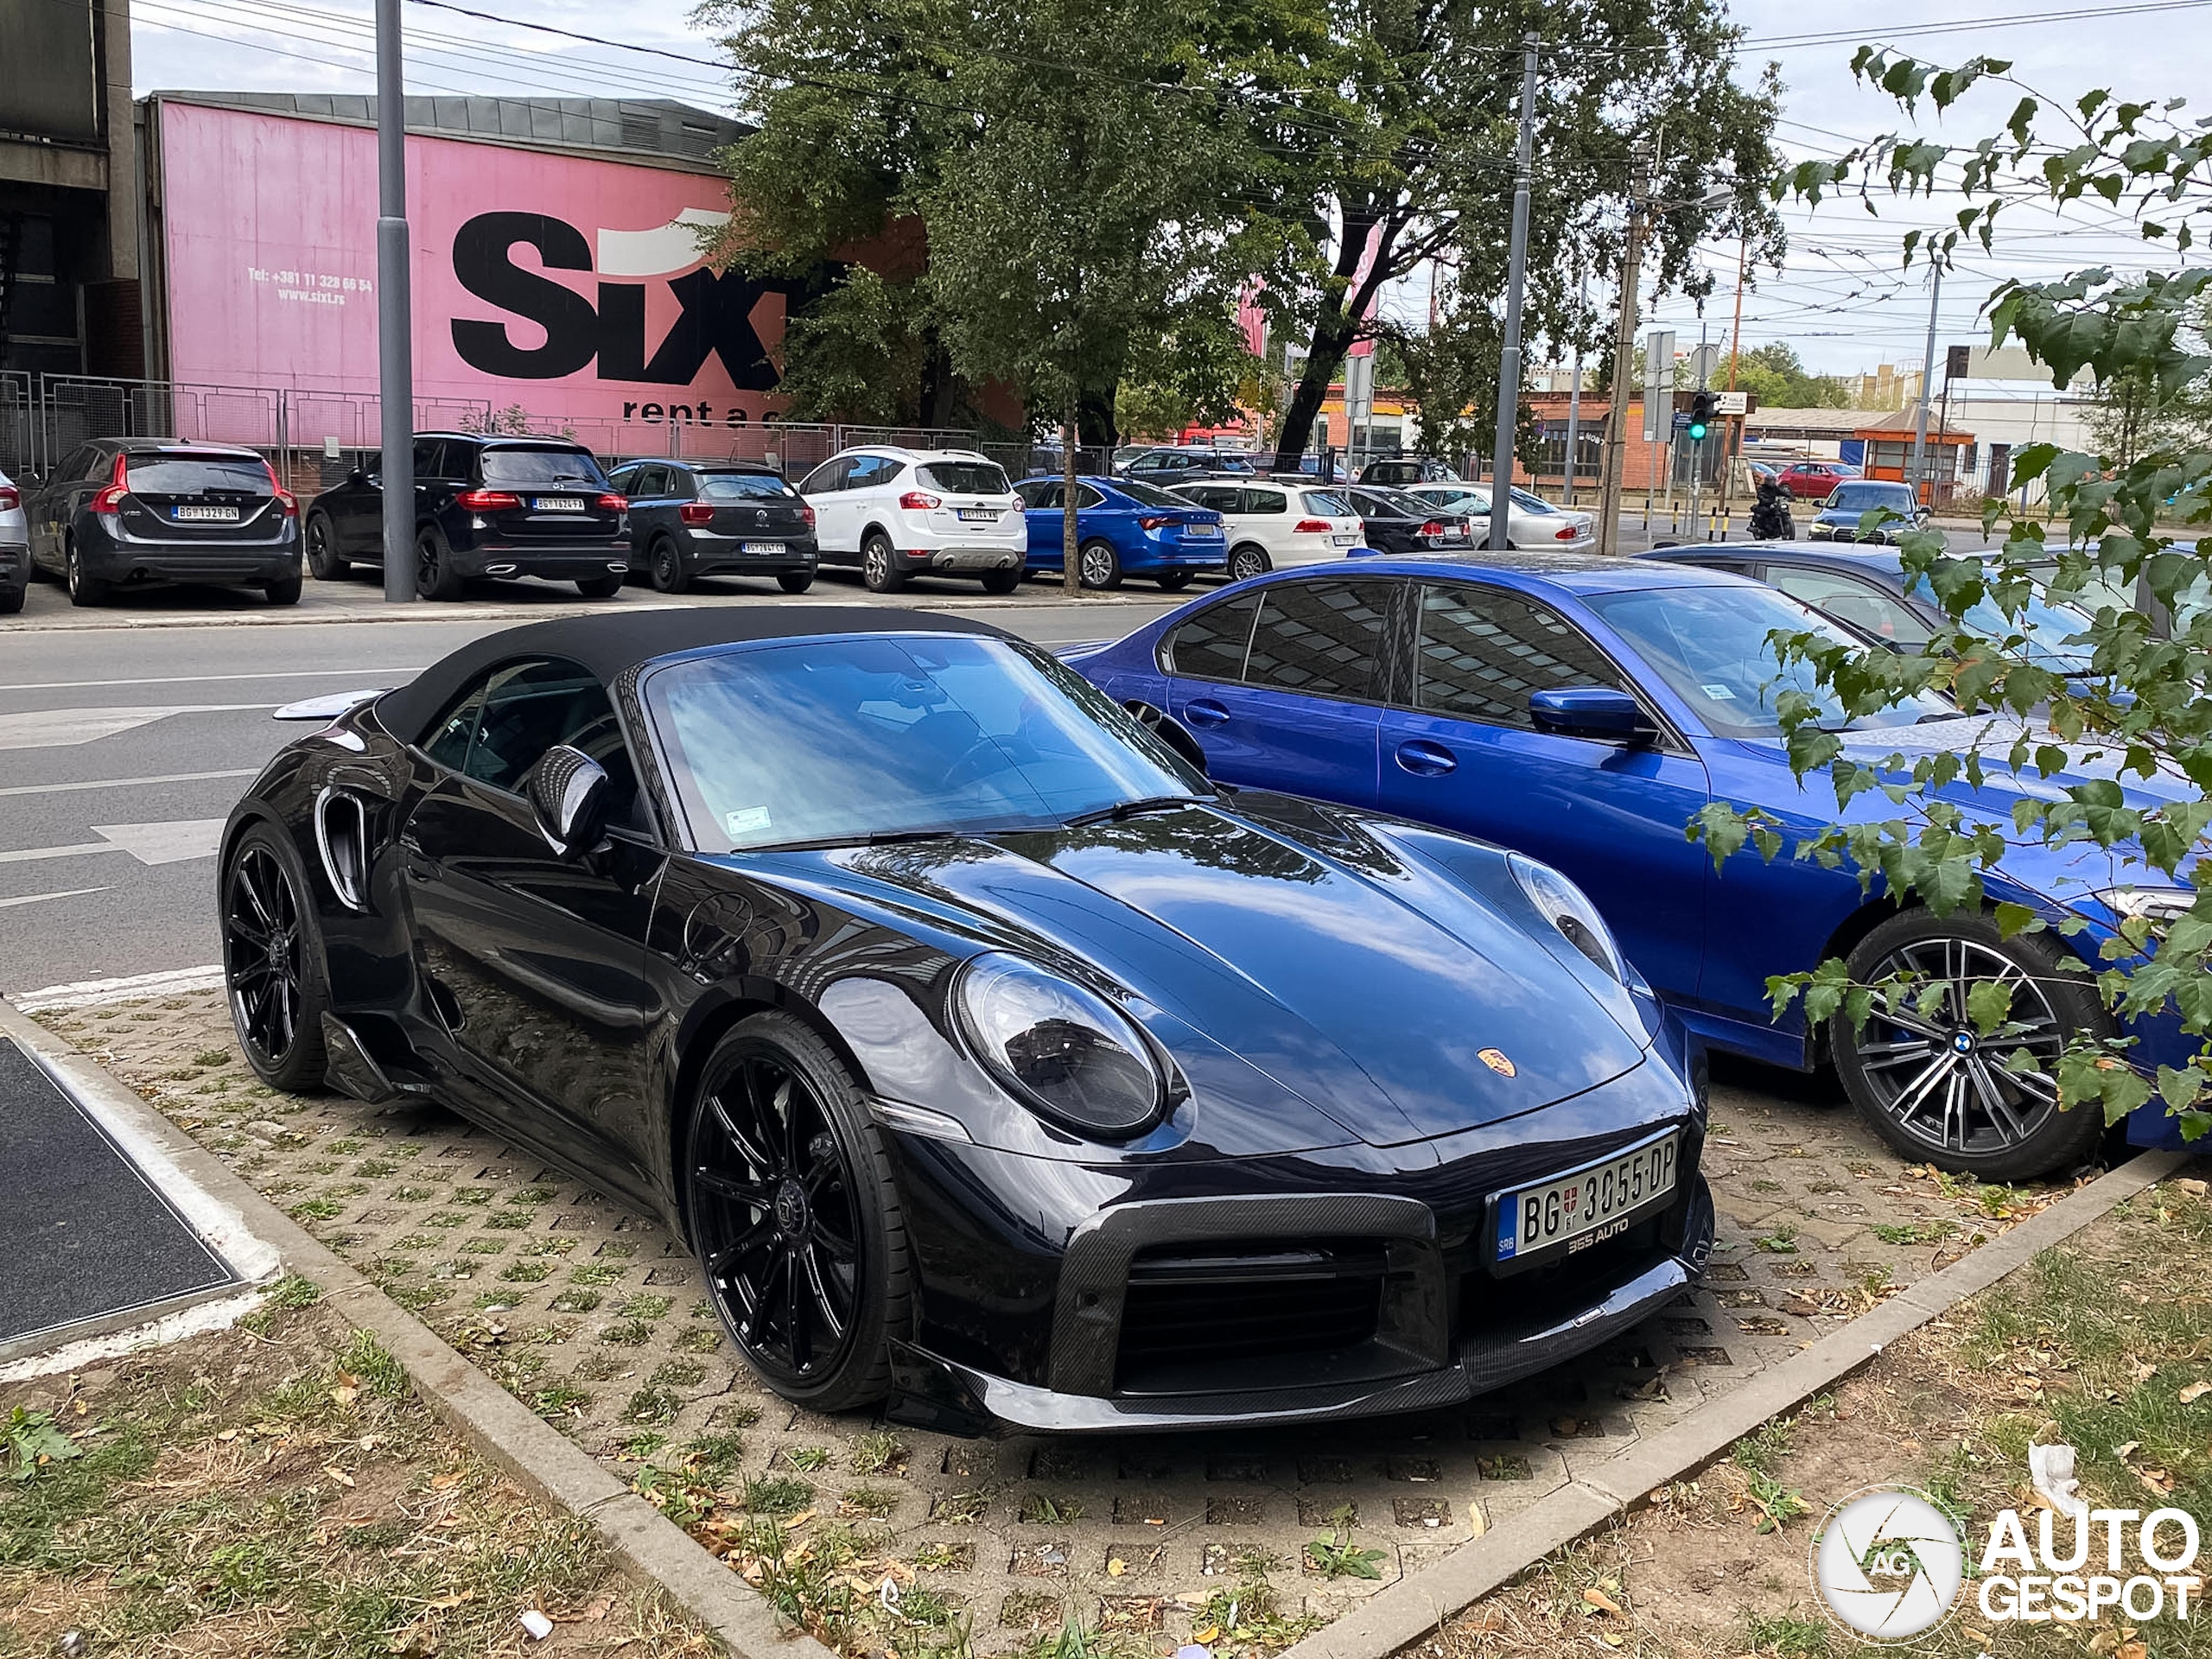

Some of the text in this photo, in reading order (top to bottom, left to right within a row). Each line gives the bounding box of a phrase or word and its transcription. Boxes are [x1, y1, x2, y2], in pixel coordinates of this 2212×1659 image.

[247, 267, 372, 293] Tel: +381 11 328 66 54
[277, 288, 346, 305] www.sixt.rs
[623, 400, 712, 427] rent
[726, 408, 747, 429] a
[180, 507, 192, 518] BG
[1523, 1190, 1560, 1245] BG
[1497, 1236, 1515, 1254] SRB
[1567, 1217, 1630, 1255] 365 AUTO
